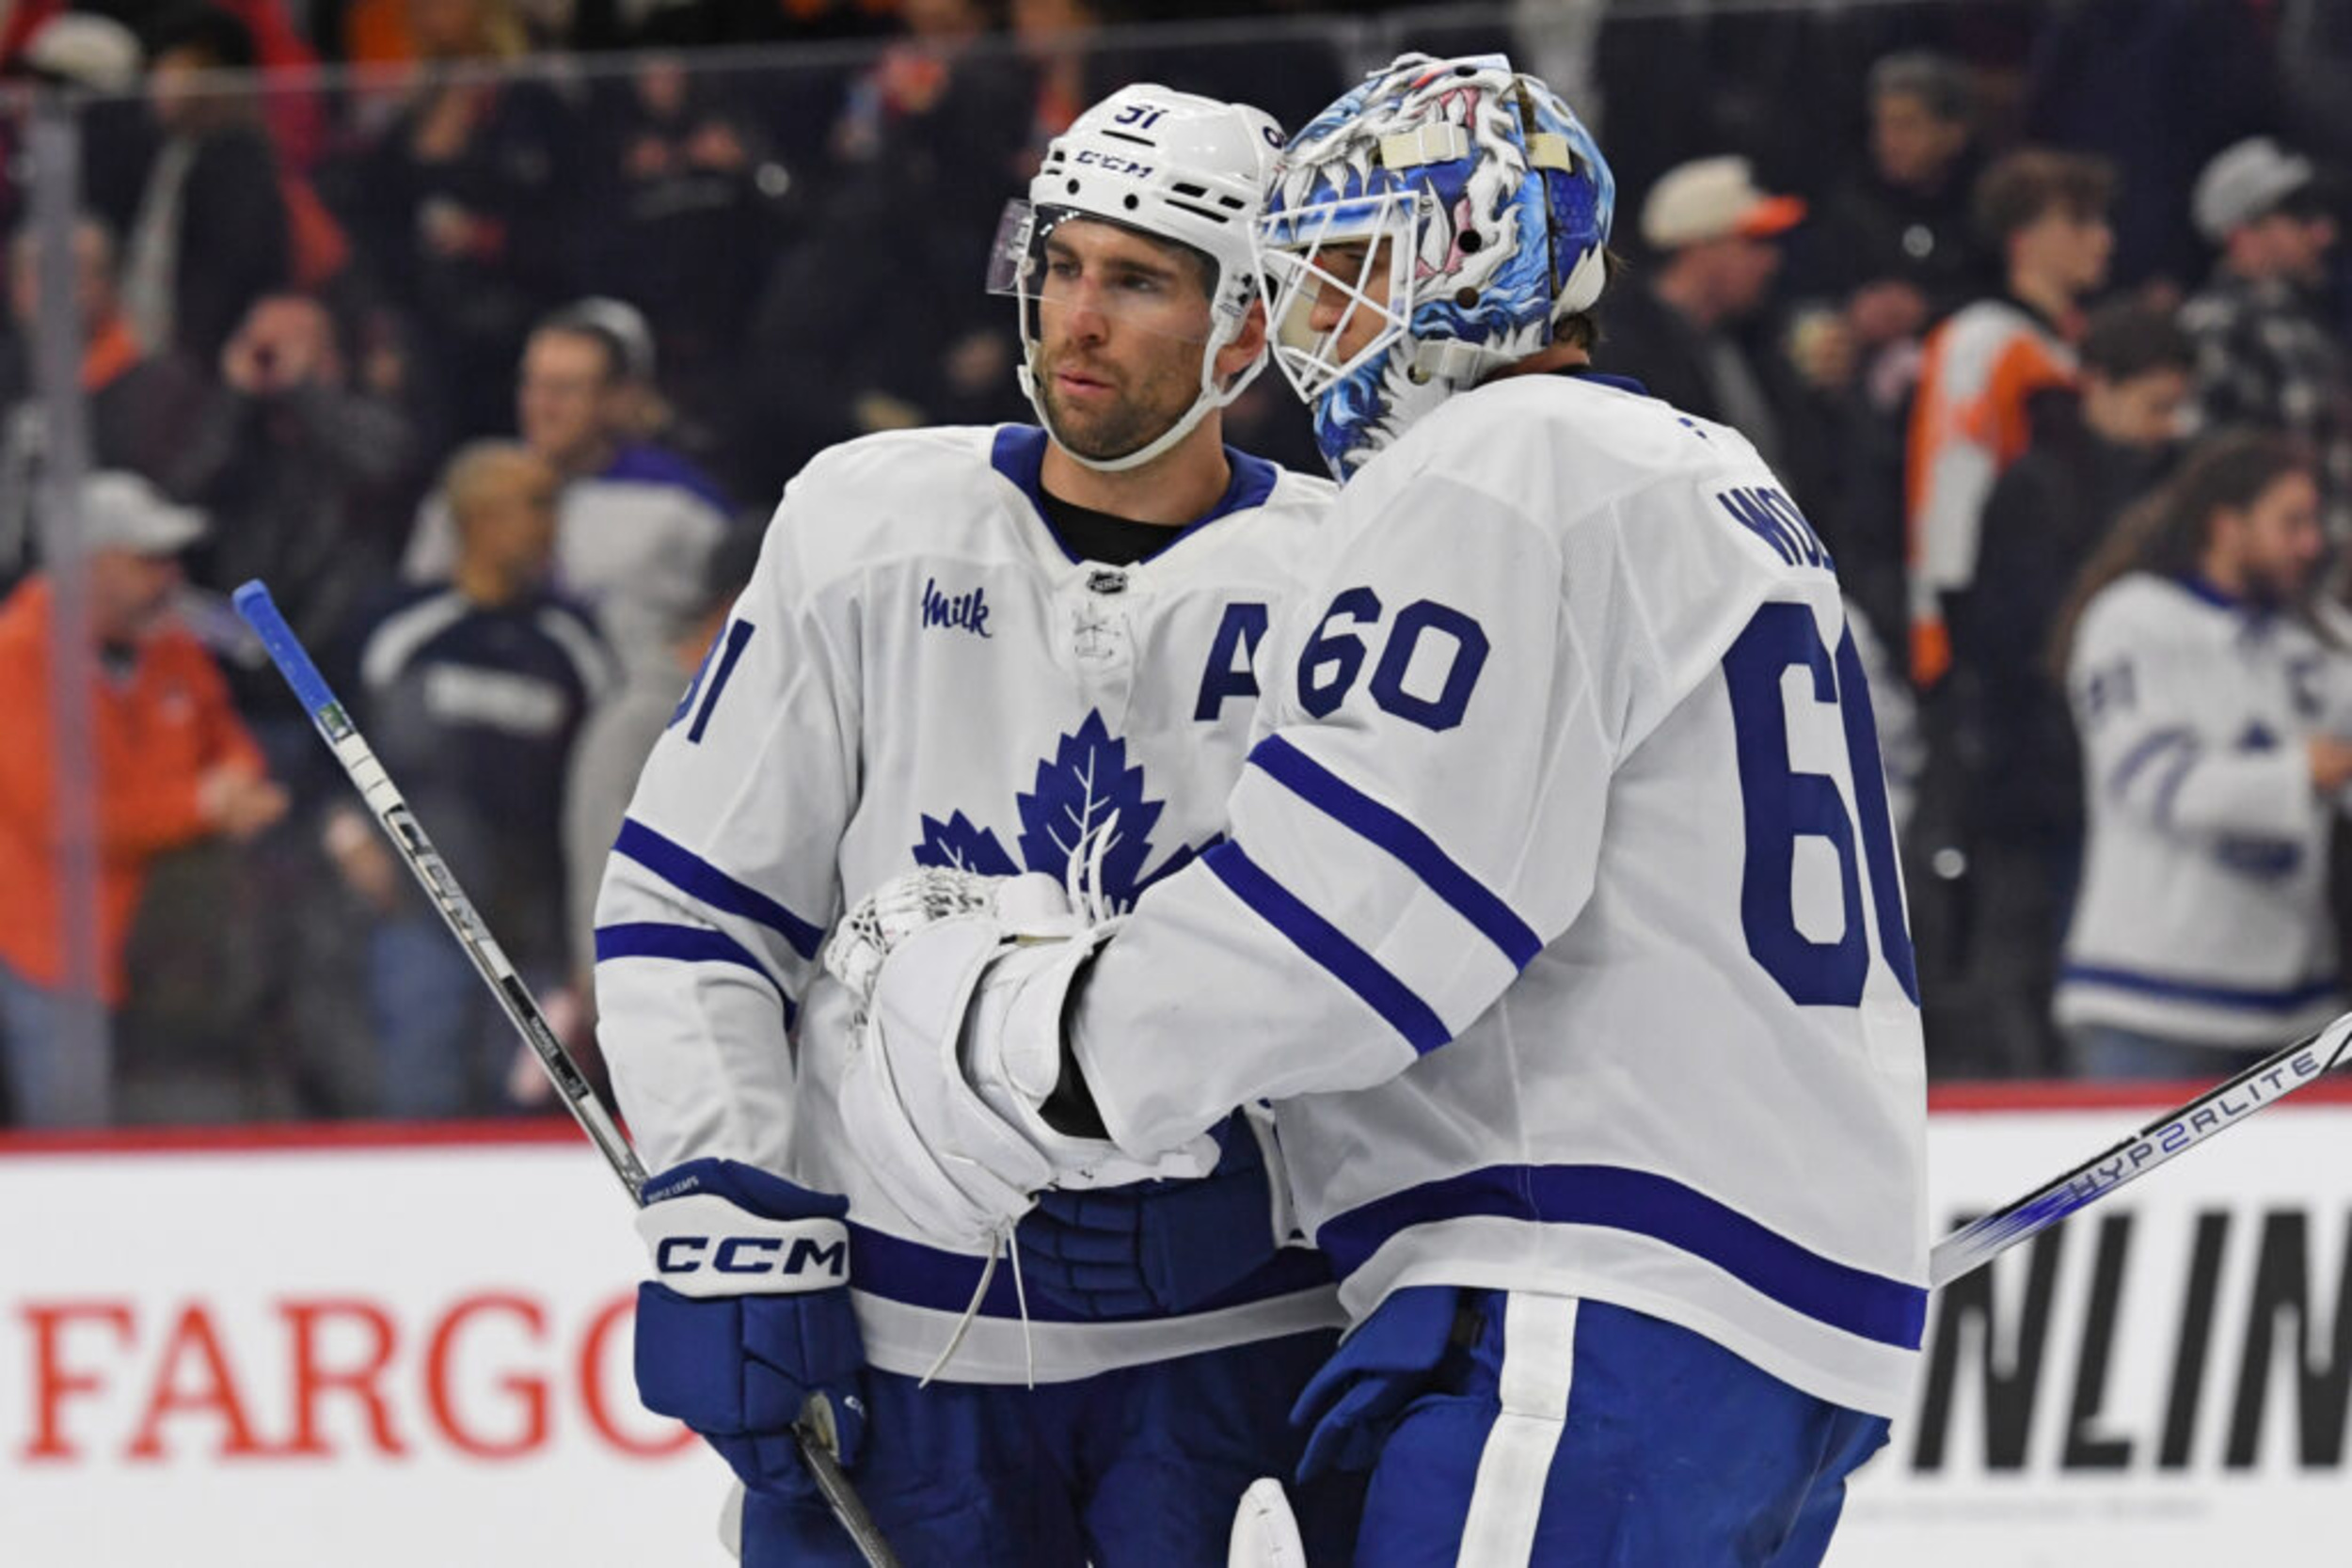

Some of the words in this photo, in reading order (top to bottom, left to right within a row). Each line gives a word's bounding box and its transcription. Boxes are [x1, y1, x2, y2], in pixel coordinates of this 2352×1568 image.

[1075, 150, 1153, 178] CCM
[1716, 486, 1836, 572] WO
[922, 578, 993, 638] Milk
[1193, 603, 1269, 721] A
[1297, 586, 1490, 733] 60
[657, 1236, 847, 1276] CCM
